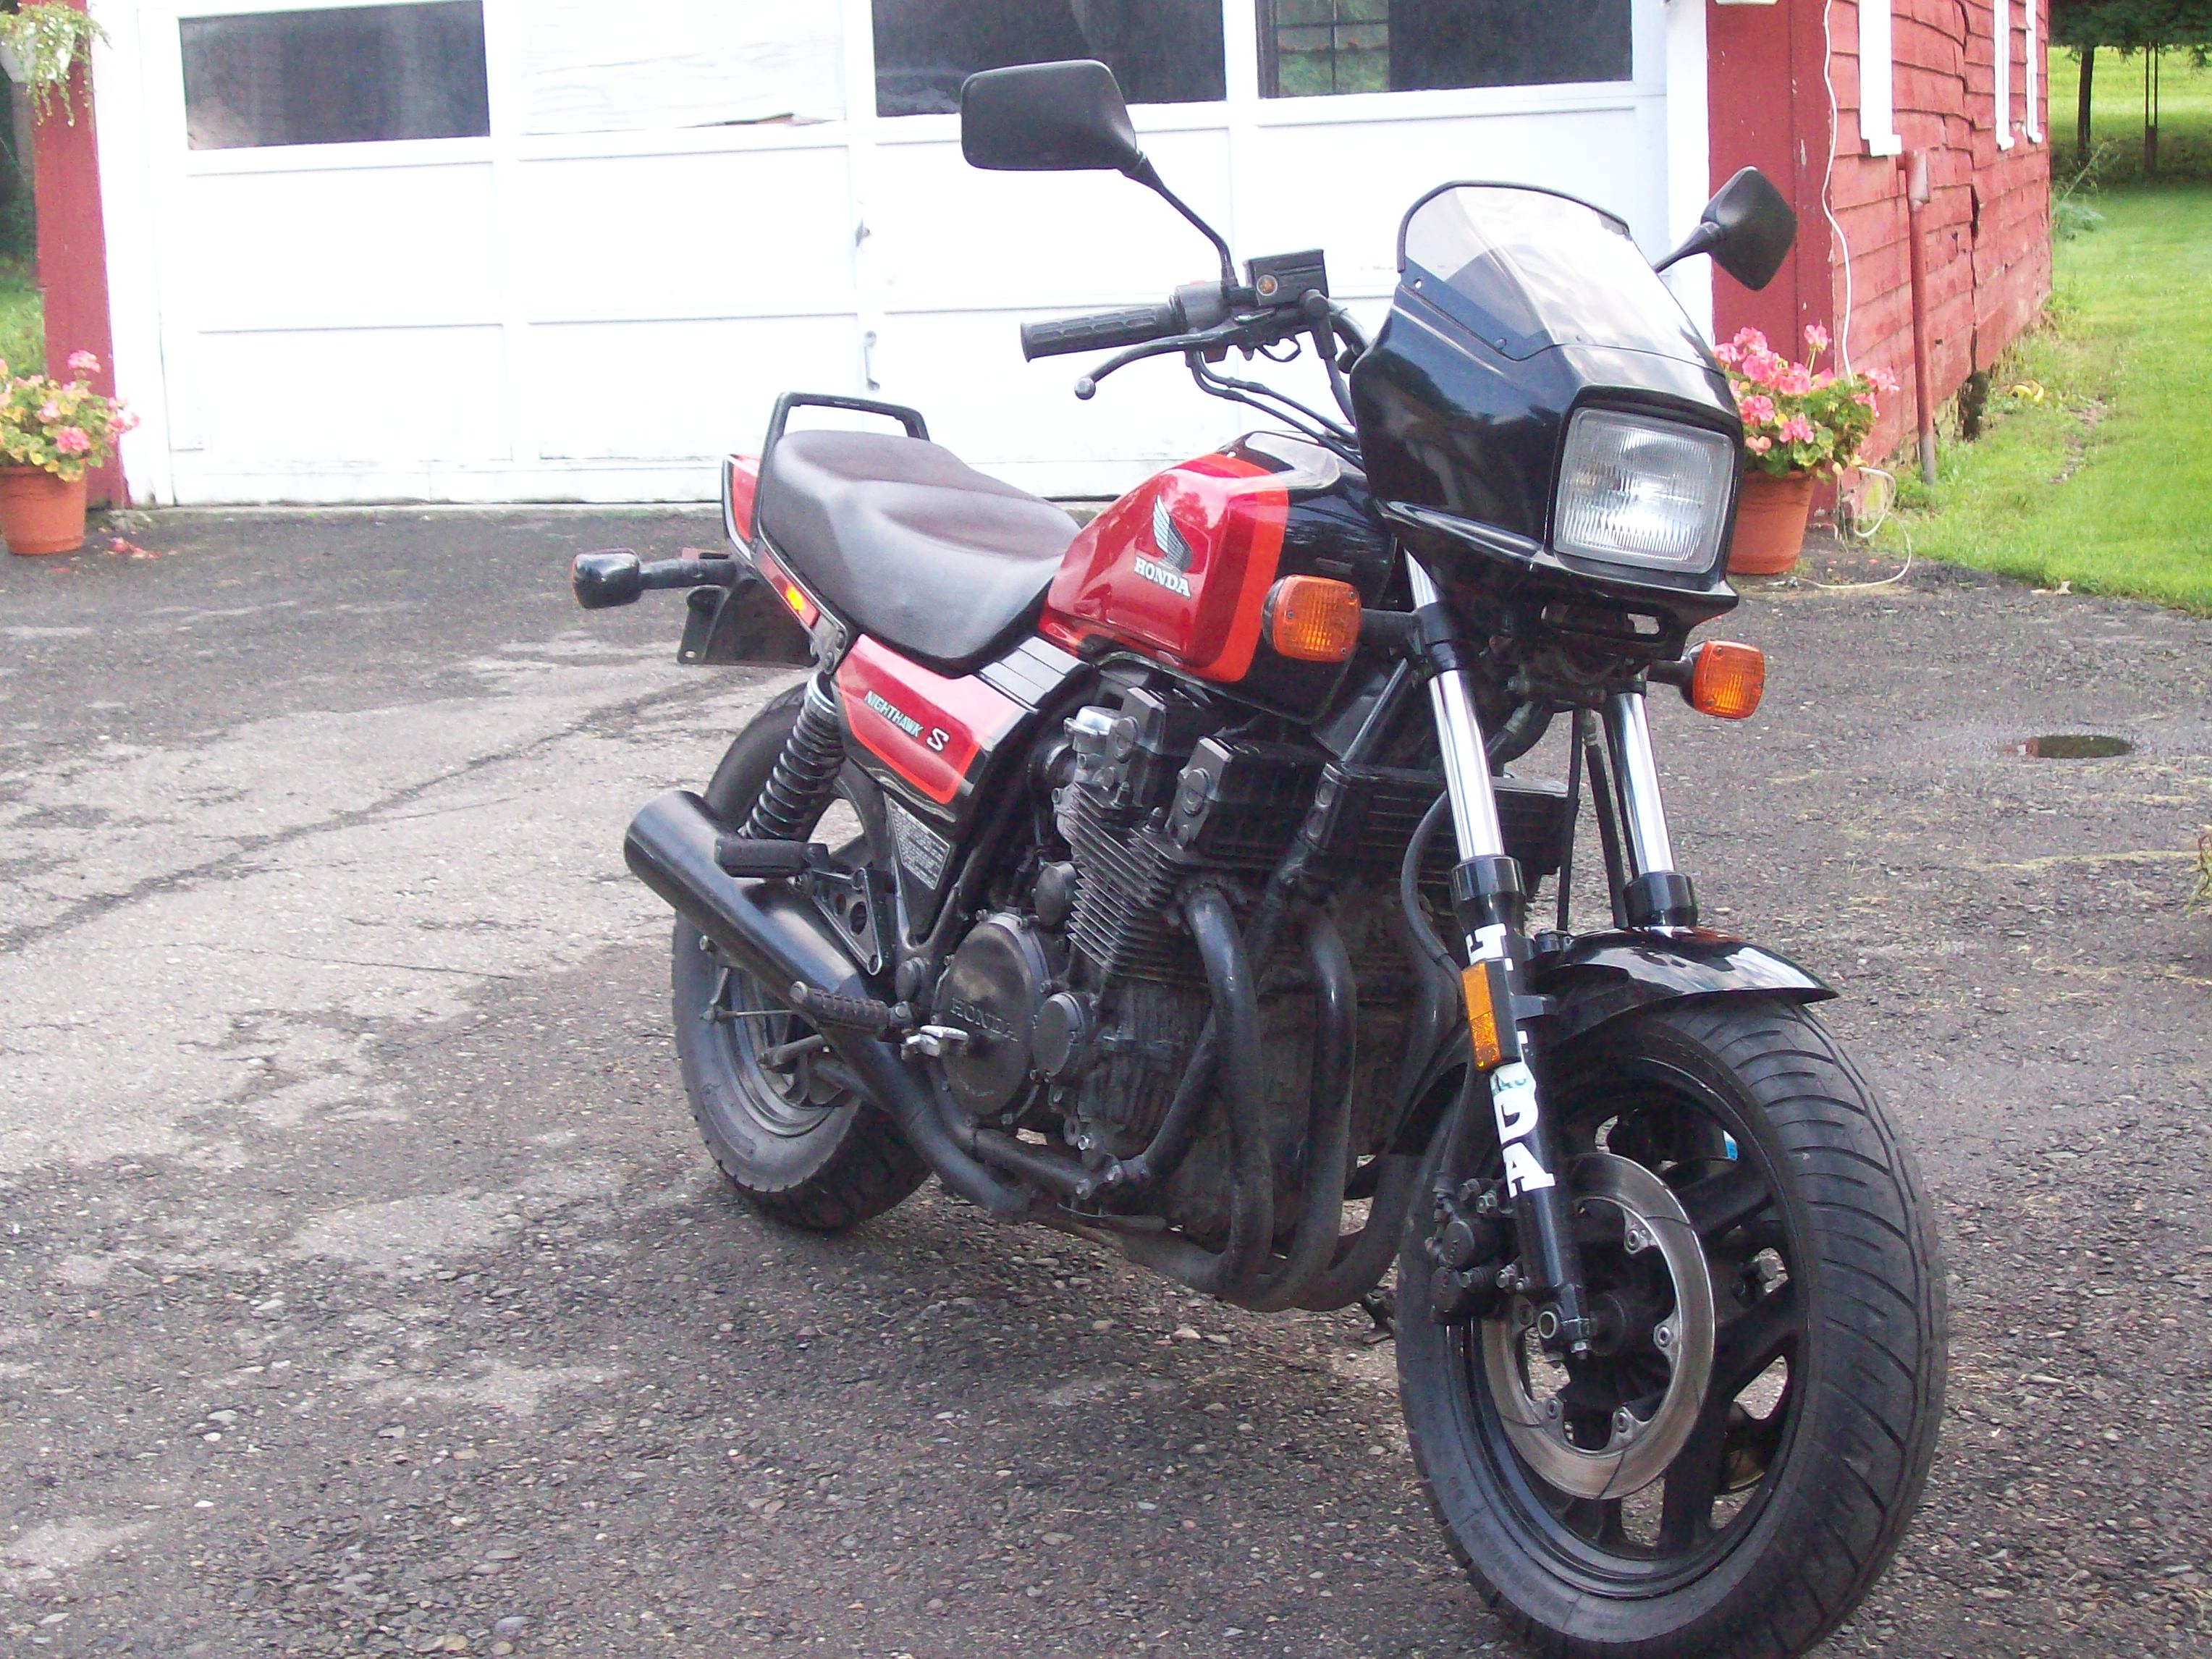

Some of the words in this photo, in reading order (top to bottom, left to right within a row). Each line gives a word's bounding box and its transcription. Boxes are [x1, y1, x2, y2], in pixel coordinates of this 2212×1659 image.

[1134, 556, 1191, 599] HONDA
[864, 690, 924, 738] NIGHTHAWK
[926, 727, 950, 751] S
